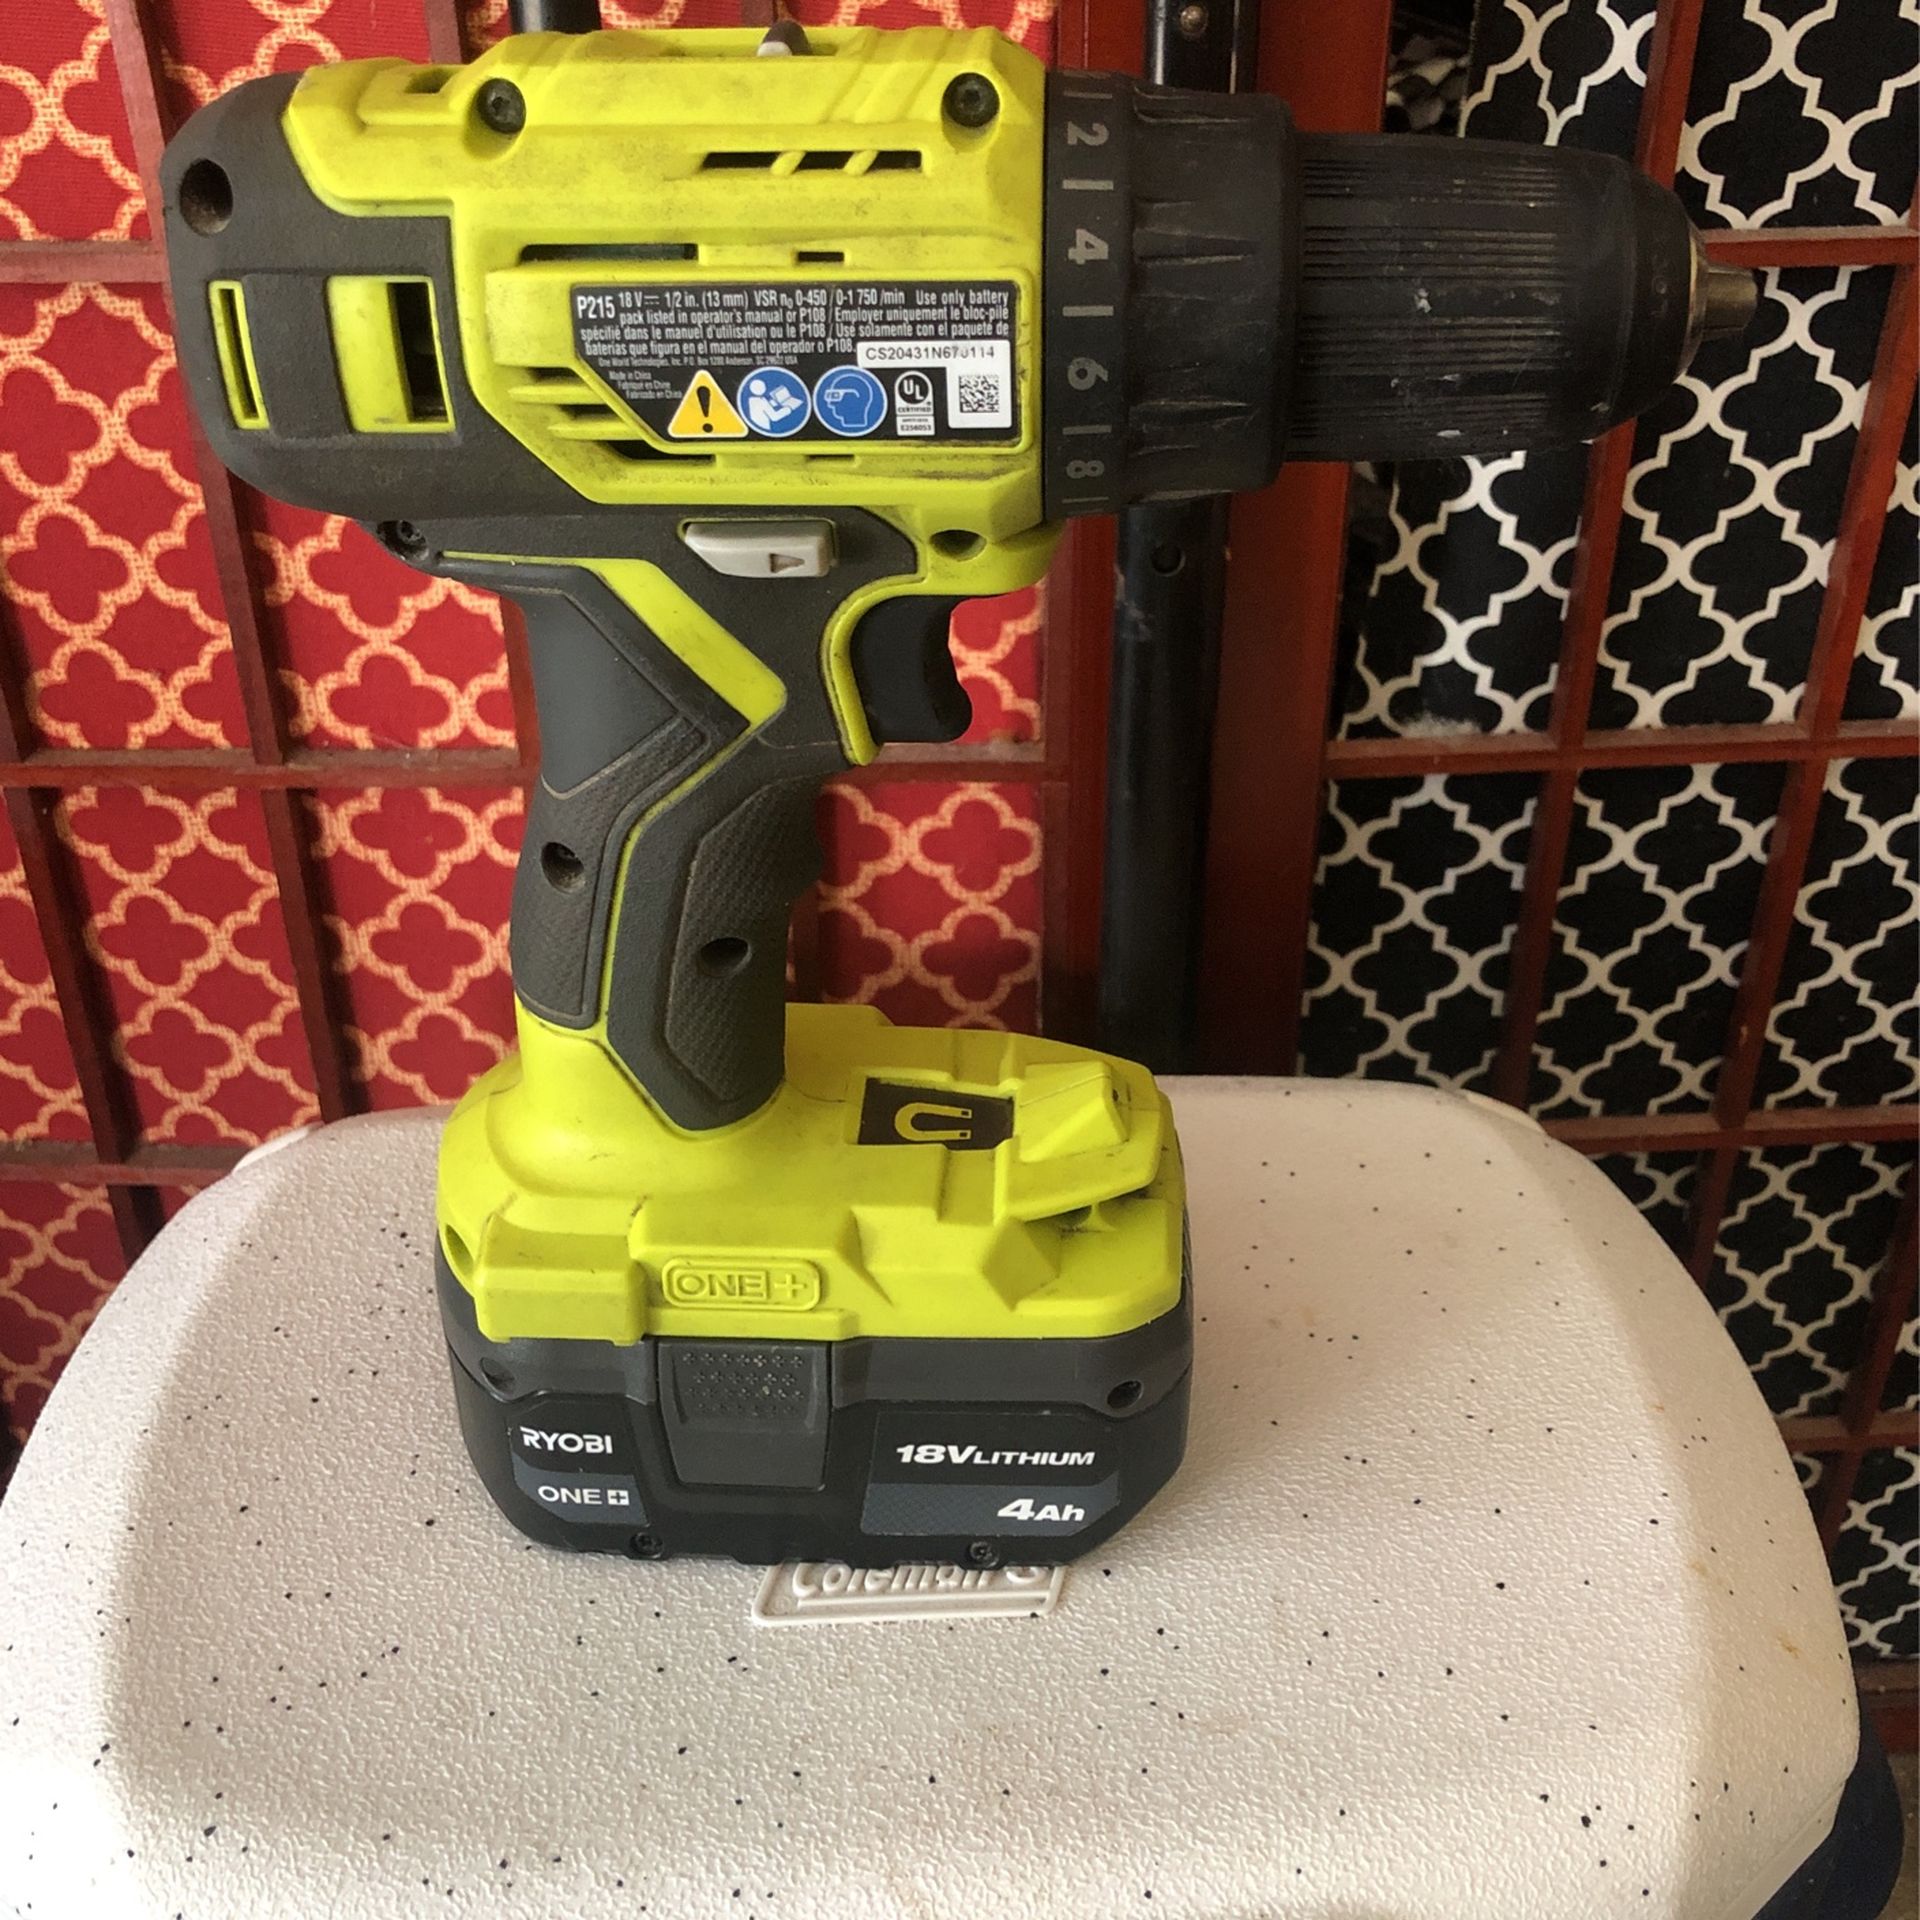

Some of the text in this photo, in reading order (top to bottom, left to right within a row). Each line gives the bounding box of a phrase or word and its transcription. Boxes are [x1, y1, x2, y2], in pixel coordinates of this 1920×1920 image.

[1067, 121, 1109, 146] 2
[1068, 229, 1109, 265] 4
[577, 295, 616, 319] P215
[619, 291, 633, 308] 18
[664, 291, 682, 309] 1/2
[684, 290, 700, 307] in.
[702, 290, 720, 311] (13
[722, 290, 749, 311] mm)
[754, 289, 778, 307] VSR
[795, 289, 827, 306] 0-450
[916, 289, 937, 305] Use
[942, 289, 965, 308] only
[970, 289, 1009, 307] battery
[620, 310, 645, 328] pack
[646, 310, 675, 324] listed
[677, 310, 688, 323] in
[691, 309, 743, 328] operator's
[745, 308, 783, 323] manual
[786, 310, 798, 322] or
[799, 307, 827, 322] P108
[835, 306, 883, 326] Employer
[887, 306, 948, 325] uniquement
[951, 306, 961, 320] le
[963, 305, 1009, 324] bloc-pile
[581, 325, 621, 343] spécifié
[624, 325, 650, 340] dans
[651, 325, 662, 340] le
[665, 325, 704, 340] manuel
[707, 324, 768, 339] d'utilisation
[770, 326, 783, 339] ou
[786, 323, 797, 338] le
[799, 323, 827, 338] P108
[836, 322, 857, 337] Use
[859, 322, 913, 337] solamente
[916, 323, 935, 336] con
[938, 321, 948, 336] el
[951, 322, 993, 339] paquete
[996, 321, 1009, 336] de
[629, 343, 649, 358] que
[650, 341, 681, 359] figura
[682, 343, 695, 355] en
[697, 340, 709, 355] el
[710, 340, 749, 354] manual
[751, 339, 767, 354] del
[769, 339, 815, 358] operador
[817, 342, 825, 353] o
[1067, 357, 1108, 390] 6
[902, 379, 925, 401] UL
[1066, 460, 1105, 479] 8
[519, 1426, 613, 1454] RYOBI
[997, 1498, 1085, 1521] 4Ah
